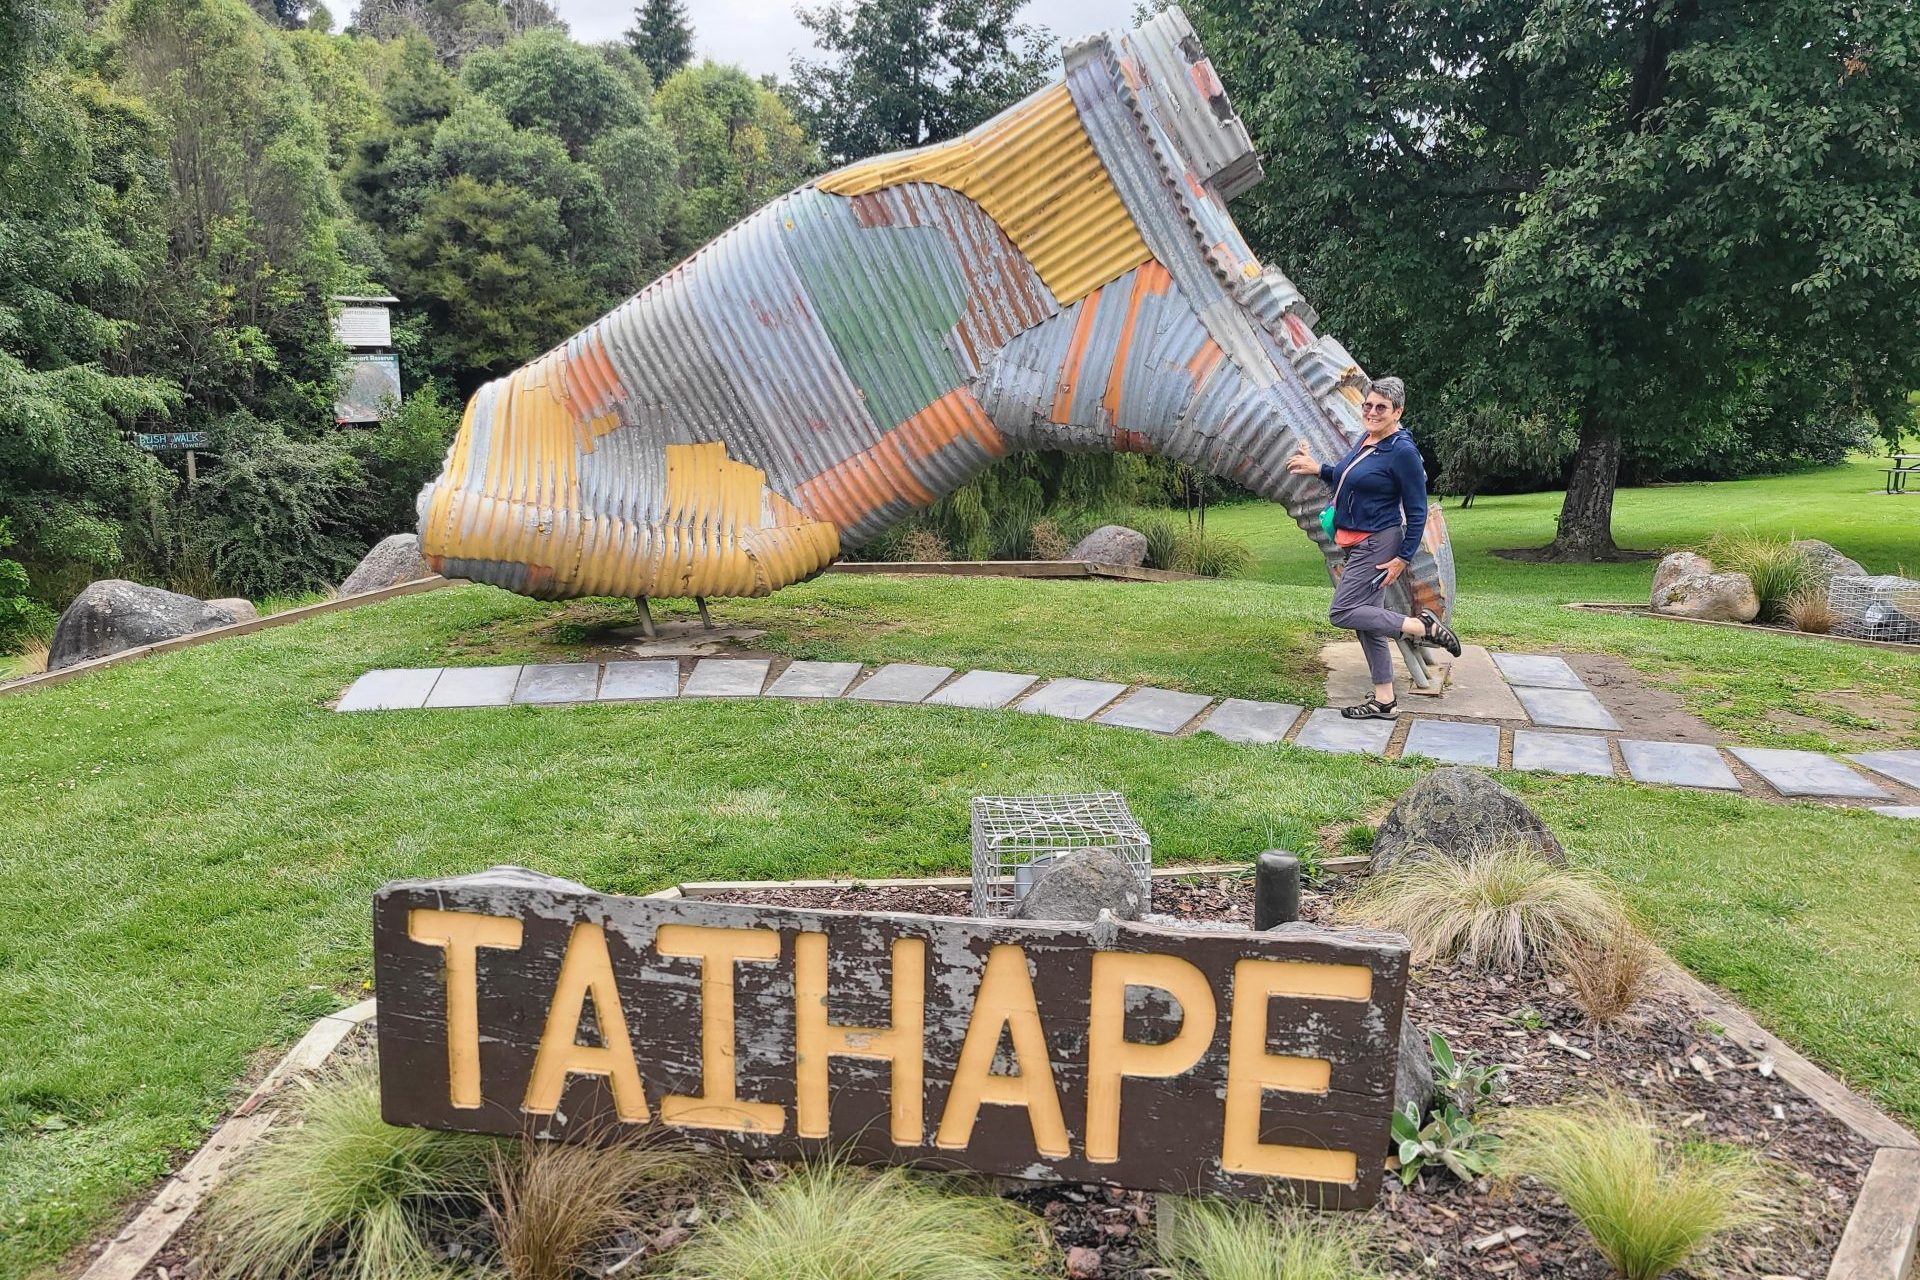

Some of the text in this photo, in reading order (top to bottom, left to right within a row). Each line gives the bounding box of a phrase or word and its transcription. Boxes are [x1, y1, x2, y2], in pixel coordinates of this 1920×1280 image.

[140, 433, 199, 444] BUSH WALK
[408, 908, 1371, 1184] TAIHAPE
